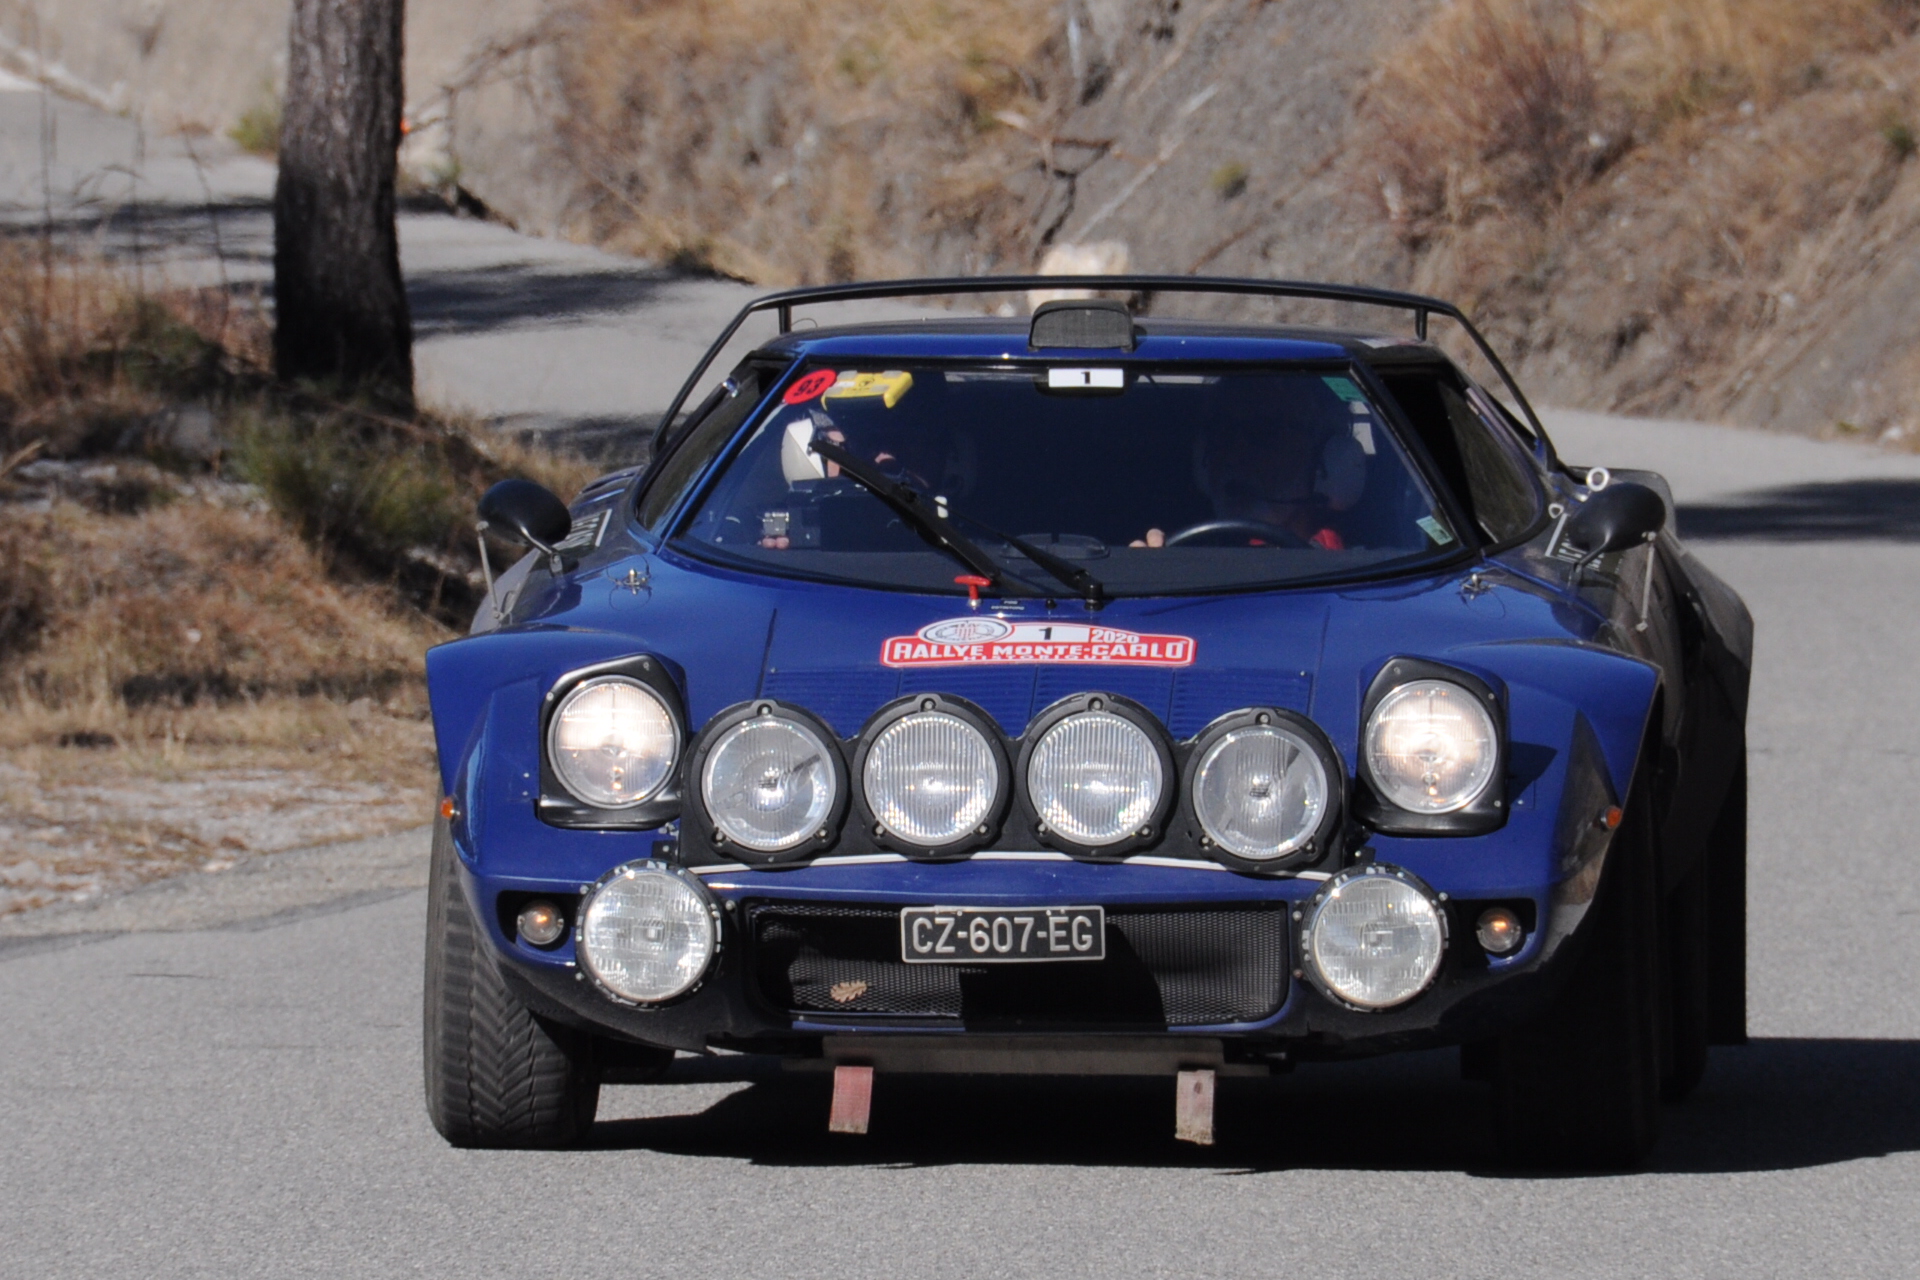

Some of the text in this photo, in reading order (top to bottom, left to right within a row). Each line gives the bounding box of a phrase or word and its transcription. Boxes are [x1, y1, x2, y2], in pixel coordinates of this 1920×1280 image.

[1081, 371, 1091, 384] 1
[1039, 626, 1140, 644] 1 2020
[893, 642, 1183, 660] RALLYE MONTE-CARLO
[912, 916, 1092, 953] CZ-607-EG
